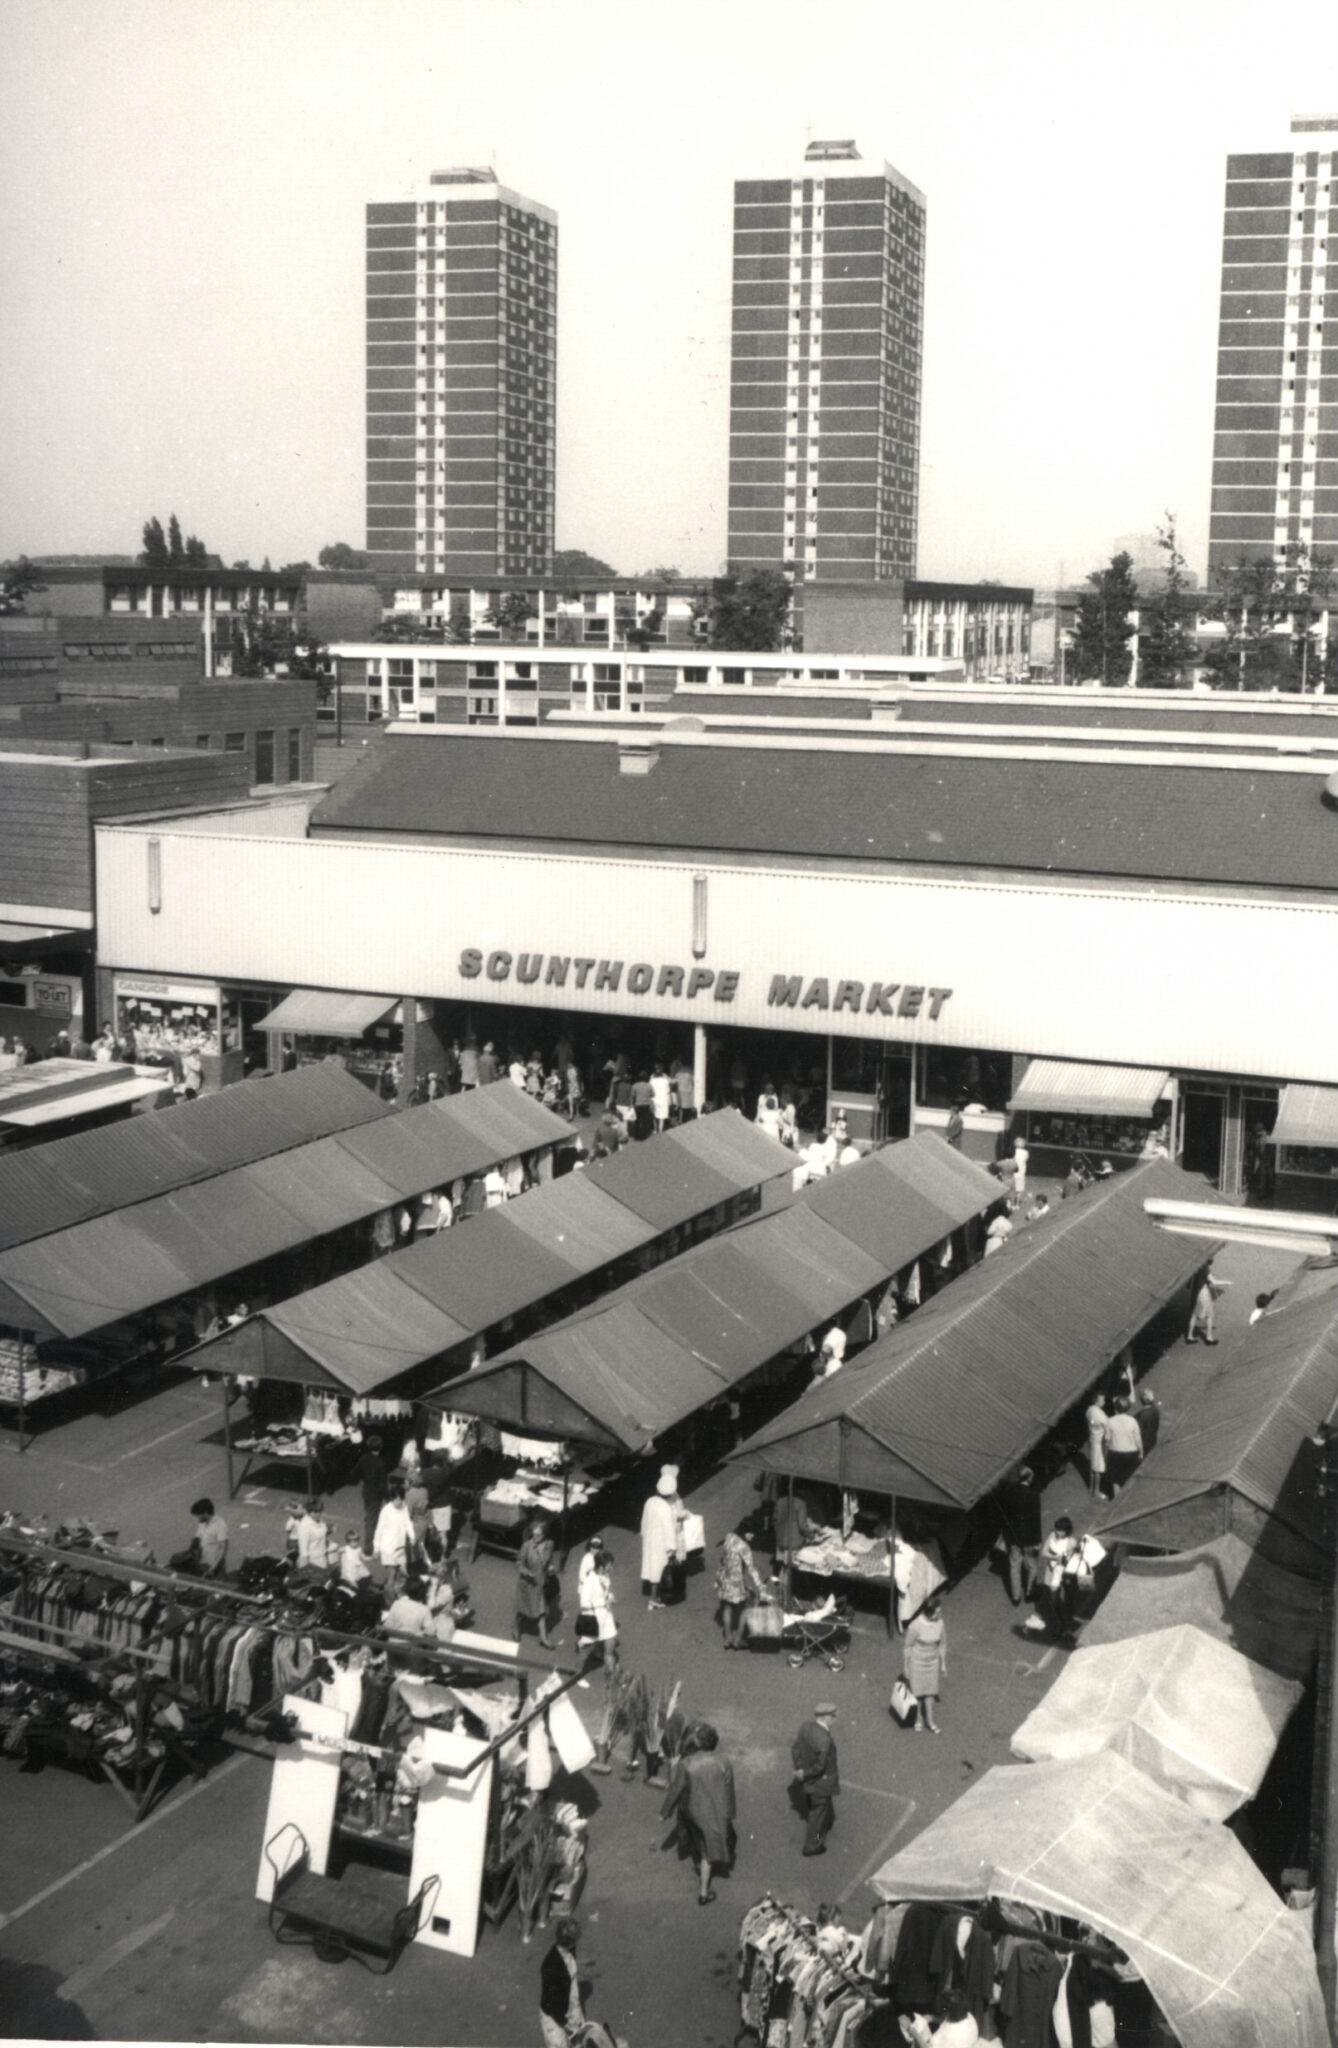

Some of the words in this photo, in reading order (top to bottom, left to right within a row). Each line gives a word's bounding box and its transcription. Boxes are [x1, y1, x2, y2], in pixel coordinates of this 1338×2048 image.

[38, 989, 50, 1000] TO
[51, 991, 66, 1001] LET
[458, 948, 740, 1003] SCUNTHORPE
[767, 974, 953, 1021] MARKET
